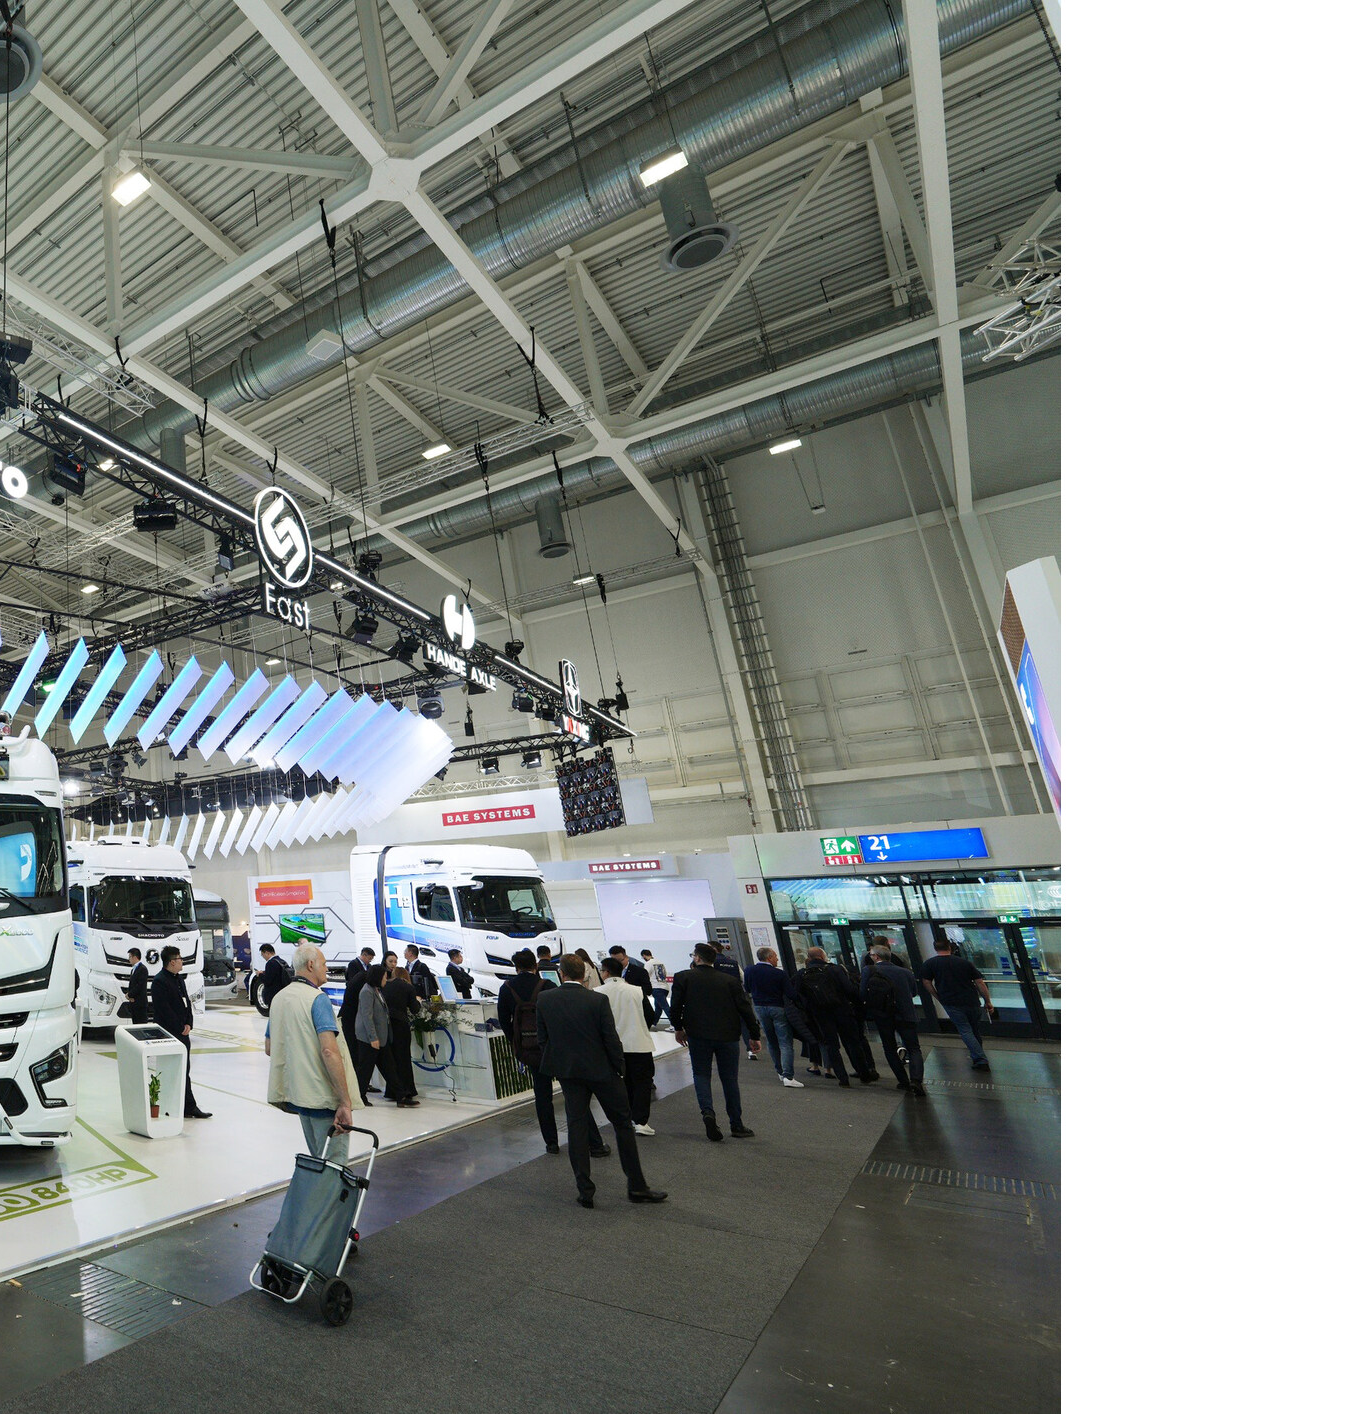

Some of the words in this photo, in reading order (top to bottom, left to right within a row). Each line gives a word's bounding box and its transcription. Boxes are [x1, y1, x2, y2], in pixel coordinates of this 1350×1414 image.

[426, 643, 467, 677] HANDE
[470, 666, 497, 692] AXLE
[446, 813, 470, 823] BAE
[473, 808, 531, 821] SYSTEMS
[867, 835, 891, 851] 21
[592, 864, 611, 872] BAE
[612, 861, 657, 871] SYSTEMS
